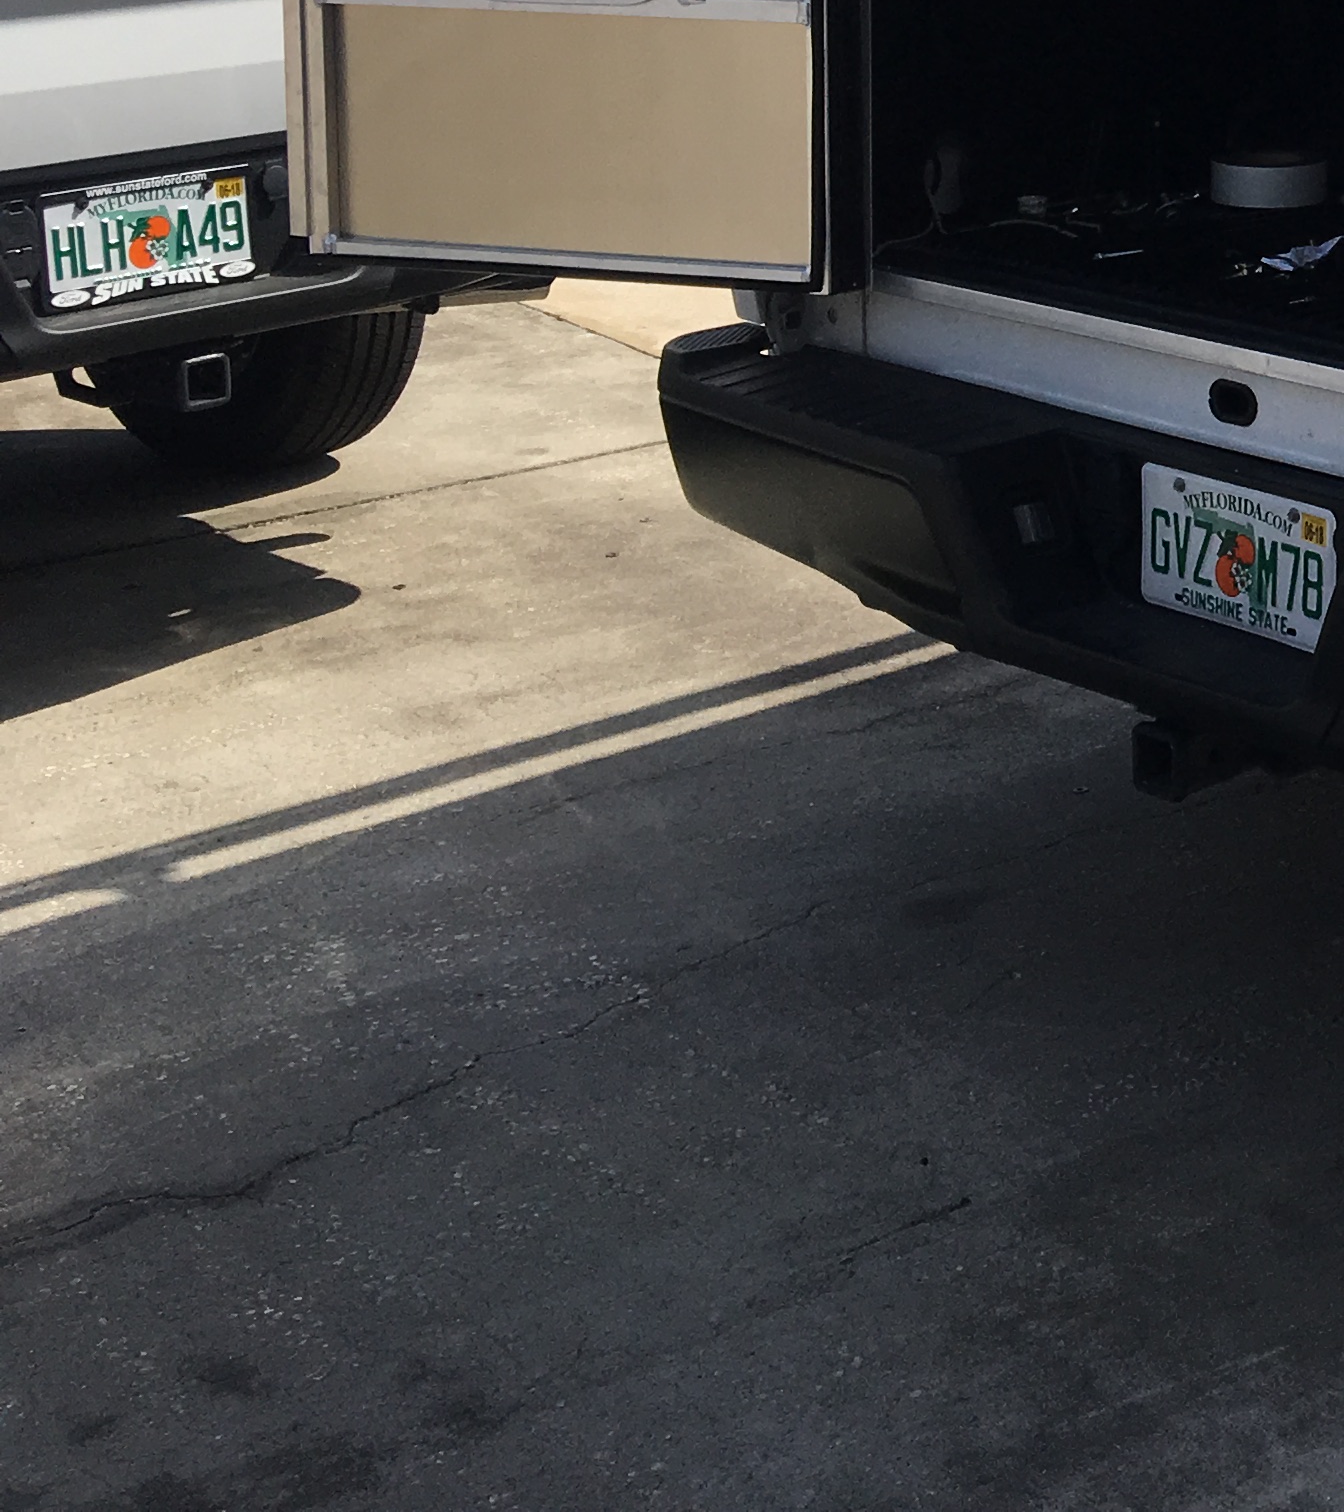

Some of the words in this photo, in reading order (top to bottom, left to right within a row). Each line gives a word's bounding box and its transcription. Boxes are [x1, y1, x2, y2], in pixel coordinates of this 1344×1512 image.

[86, 172, 208, 198] www.sunstateford.com
[51, 215, 128, 281] HLH
[175, 200, 245, 261] A49
[91, 276, 144, 306] SUN
[150, 265, 220, 288] STATE
[1183, 491, 1293, 538] MYFLORIDA.COM
[1151, 507, 1213, 588] GVZ
[1256, 536, 1324, 621] M78
[1181, 587, 1244, 622] SUNSHINE
[1248, 606, 1289, 636] STATE
